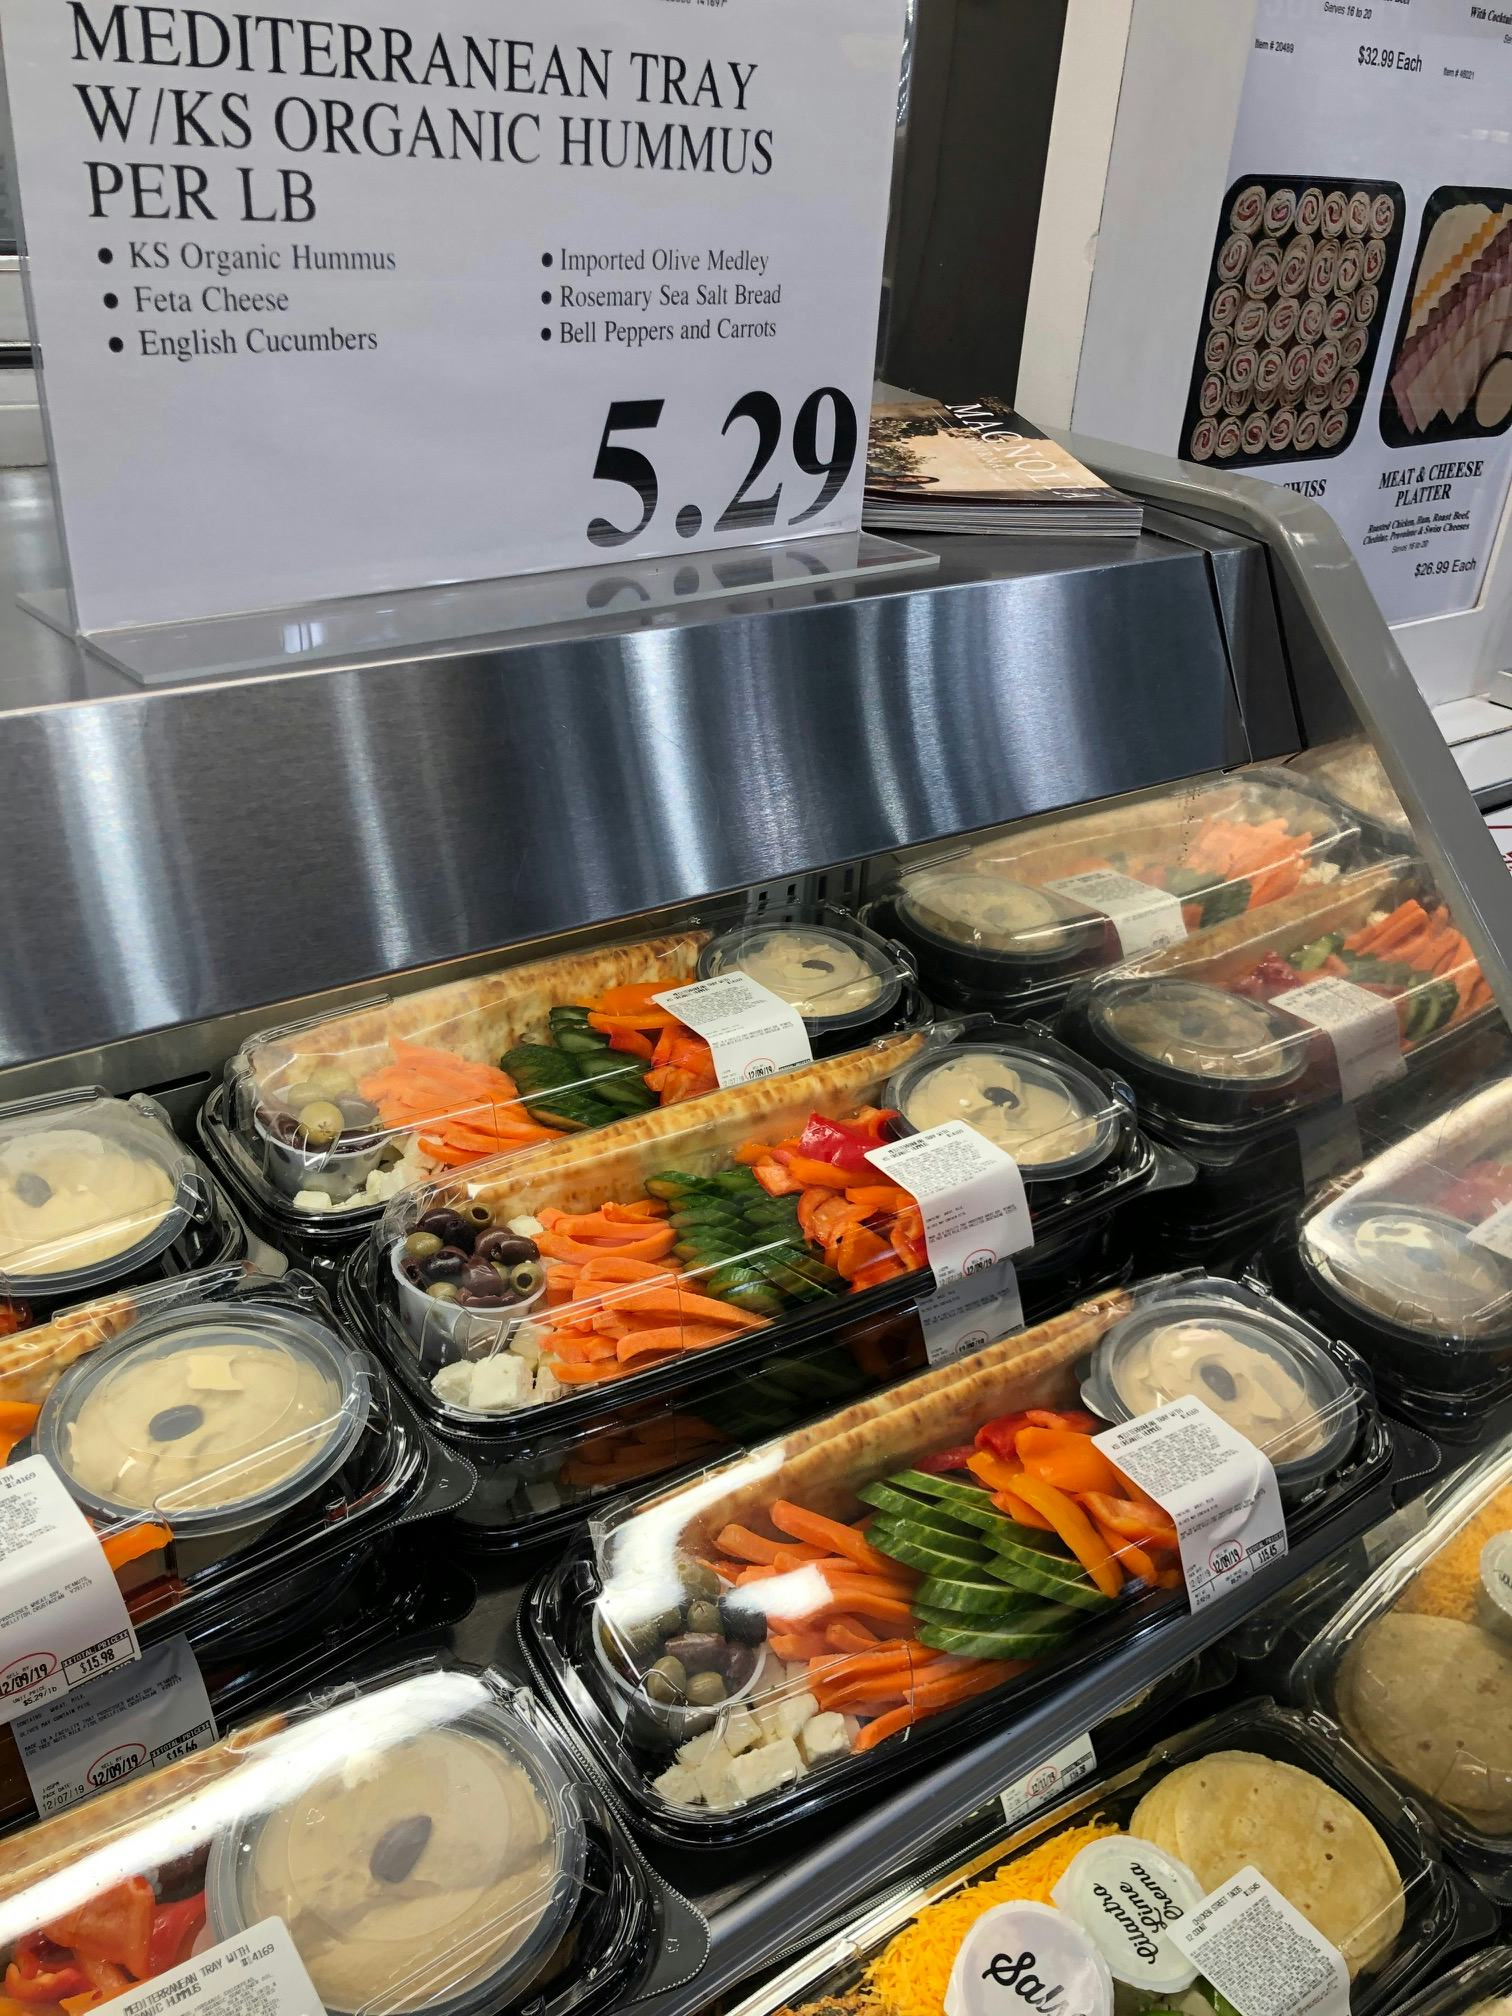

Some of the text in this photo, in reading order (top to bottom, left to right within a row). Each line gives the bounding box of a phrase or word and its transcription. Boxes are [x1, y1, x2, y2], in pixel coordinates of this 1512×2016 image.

[1324, 1, 1373, 19] Serves 16 to 20
[71, 1, 758, 110] MEDITERRANEAN TRAY
[1358, 46, 1422, 72] $32.99 Each
[73, 84, 772, 175] W/KS ORGANIC HUMMUS
[85, 162, 315, 222] PER LB
[129, 242, 395, 276] KS Organic Hummus
[562, 248, 765, 276] Imported Olive Medley
[134, 286, 288, 312] Feta Cheese
[560, 284, 781, 311] Rosemary Sea Salt Bread
[139, 327, 377, 362] English Cucumbers
[560, 318, 776, 347] Bell Peppers and Carrots
[945, 403, 1101, 498] MAGNOLIA
[587, 387, 857, 547] 5.29
[1379, 461, 1484, 489] MEAT & CHEESE
[1395, 484, 1452, 507] PLATTER
[1368, 521, 1391, 533] Roasted
[1433, 513, 1451, 524] Roast
[1415, 557, 1476, 578] $26.99 Each
[78, 1647, 117, 1675] $15.98
[89, 1753, 142, 1788] 12/09/19
[41, 1784, 87, 1812] 12/07/19
[1130, 1863, 1184, 1920] Crema
[1120, 1882, 1168, 1933] Lime
[1093, 1883, 1158, 1965] Cilantro
[123, 1944, 251, 2016] MEDITERRANEAN TRAY WITH
[165, 1981, 202, 2008] HUMMUS
